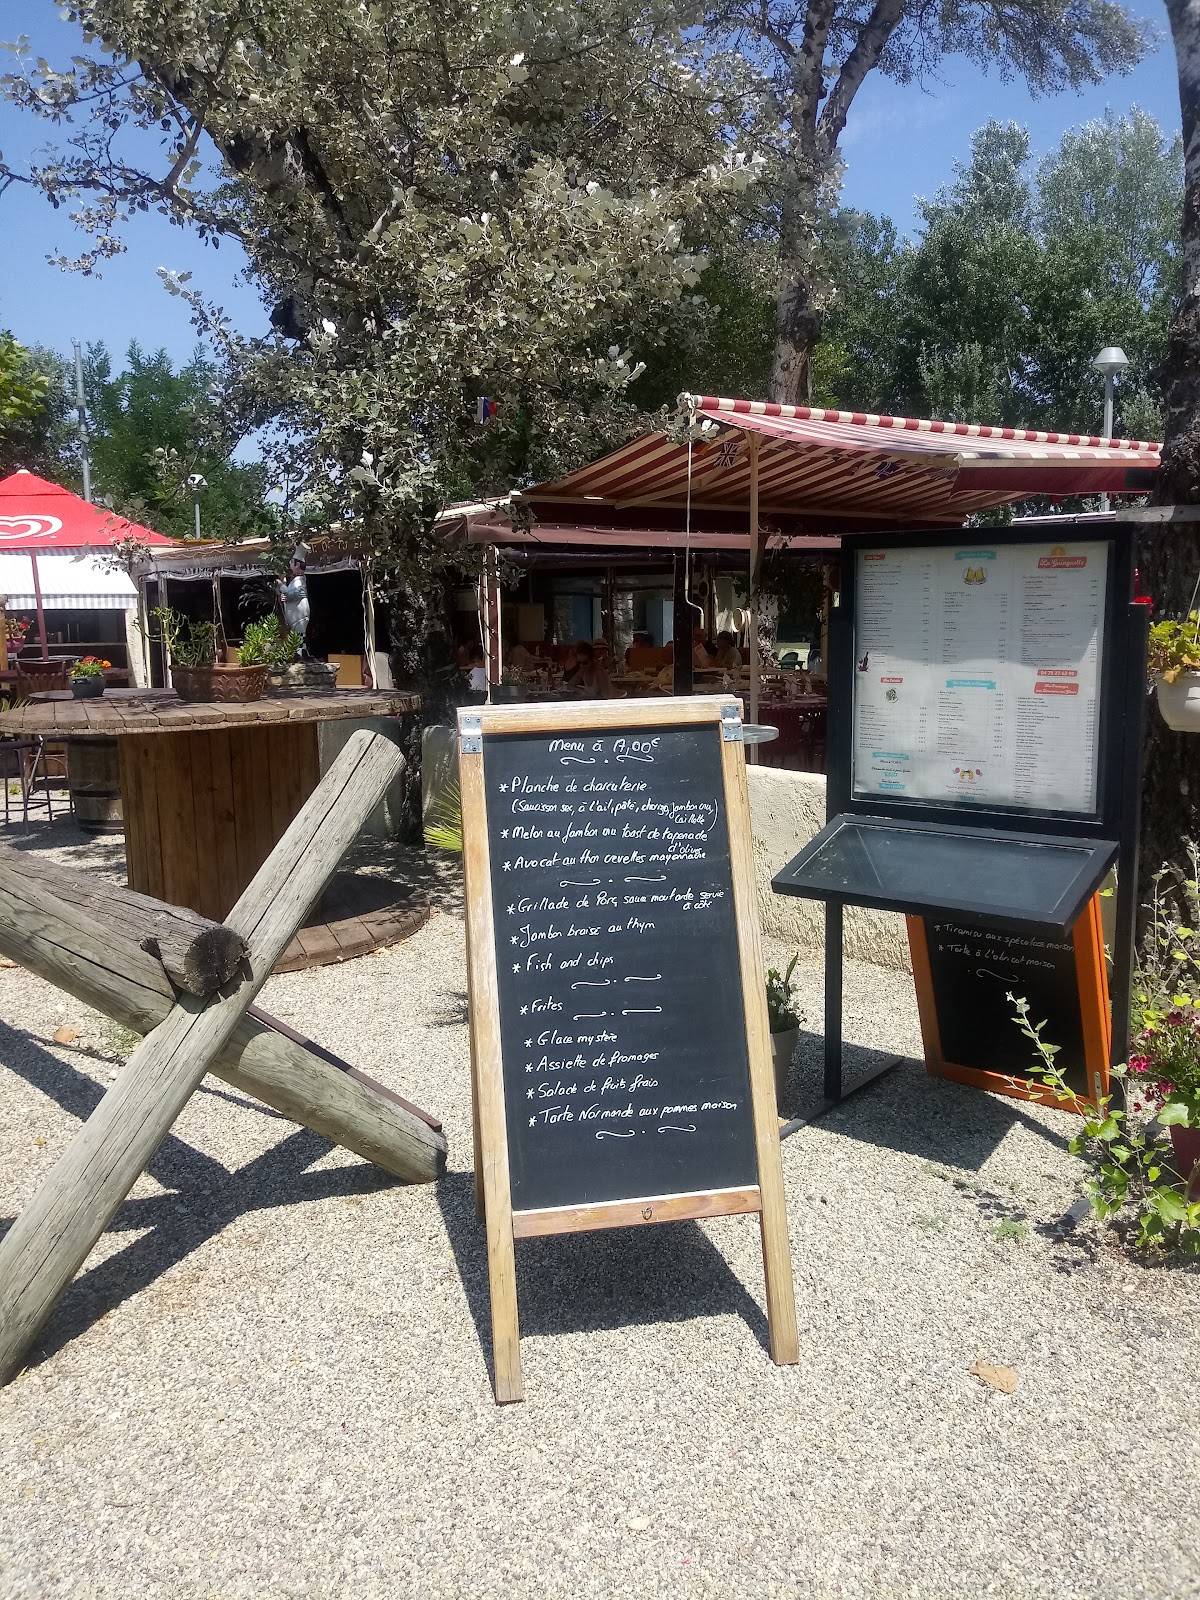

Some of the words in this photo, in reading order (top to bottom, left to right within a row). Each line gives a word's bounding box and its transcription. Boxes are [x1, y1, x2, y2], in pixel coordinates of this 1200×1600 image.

[548, 738, 585, 753] Menu
[592, 740, 604, 752] à
[511, 775, 560, 793] Planche
[565, 778, 578, 793] de
[583, 775, 648, 792] charcuterie
[578, 801, 588, 812] à
[512, 825, 543, 840] Melon
[546, 830, 561, 839] au
[621, 822, 647, 839] toast
[647, 828, 660, 840] de
[662, 827, 708, 845] tapenade
[513, 852, 560, 869] Avocat
[562, 857, 576, 866] au
[579, 848, 600, 863] thon
[517, 896, 569, 913] Grillade
[576, 894, 590, 908] de
[650, 887, 694, 903] moutarde
[519, 923, 563, 948] Jambon
[607, 924, 623, 933] au
[626, 916, 656, 934] thym
[943, 923, 983, 938] Tiramisu
[985, 932, 1002, 942] aux
[526, 952, 553, 972] Fish
[560, 952, 583, 970] and
[587, 951, 615, 969] chips
[946, 943, 971, 957] Tarte
[1025, 958, 1056, 970] maison
[531, 995, 564, 1013] Frites
[537, 1029, 574, 1046] Glace
[535, 1055, 587, 1072] Assiette
[592, 1052, 606, 1067] de
[537, 1080, 578, 1099] Salade
[583, 1079, 597, 1093] de
[600, 1076, 627, 1096] fruits
[628, 1073, 660, 1093] frais
[538, 1104, 574, 1124] Tarte
[578, 1102, 634, 1121] Normande
[639, 1106, 659, 1117] aux
[659, 1104, 698, 1119] pommes
[700, 1100, 738, 1111] maison
